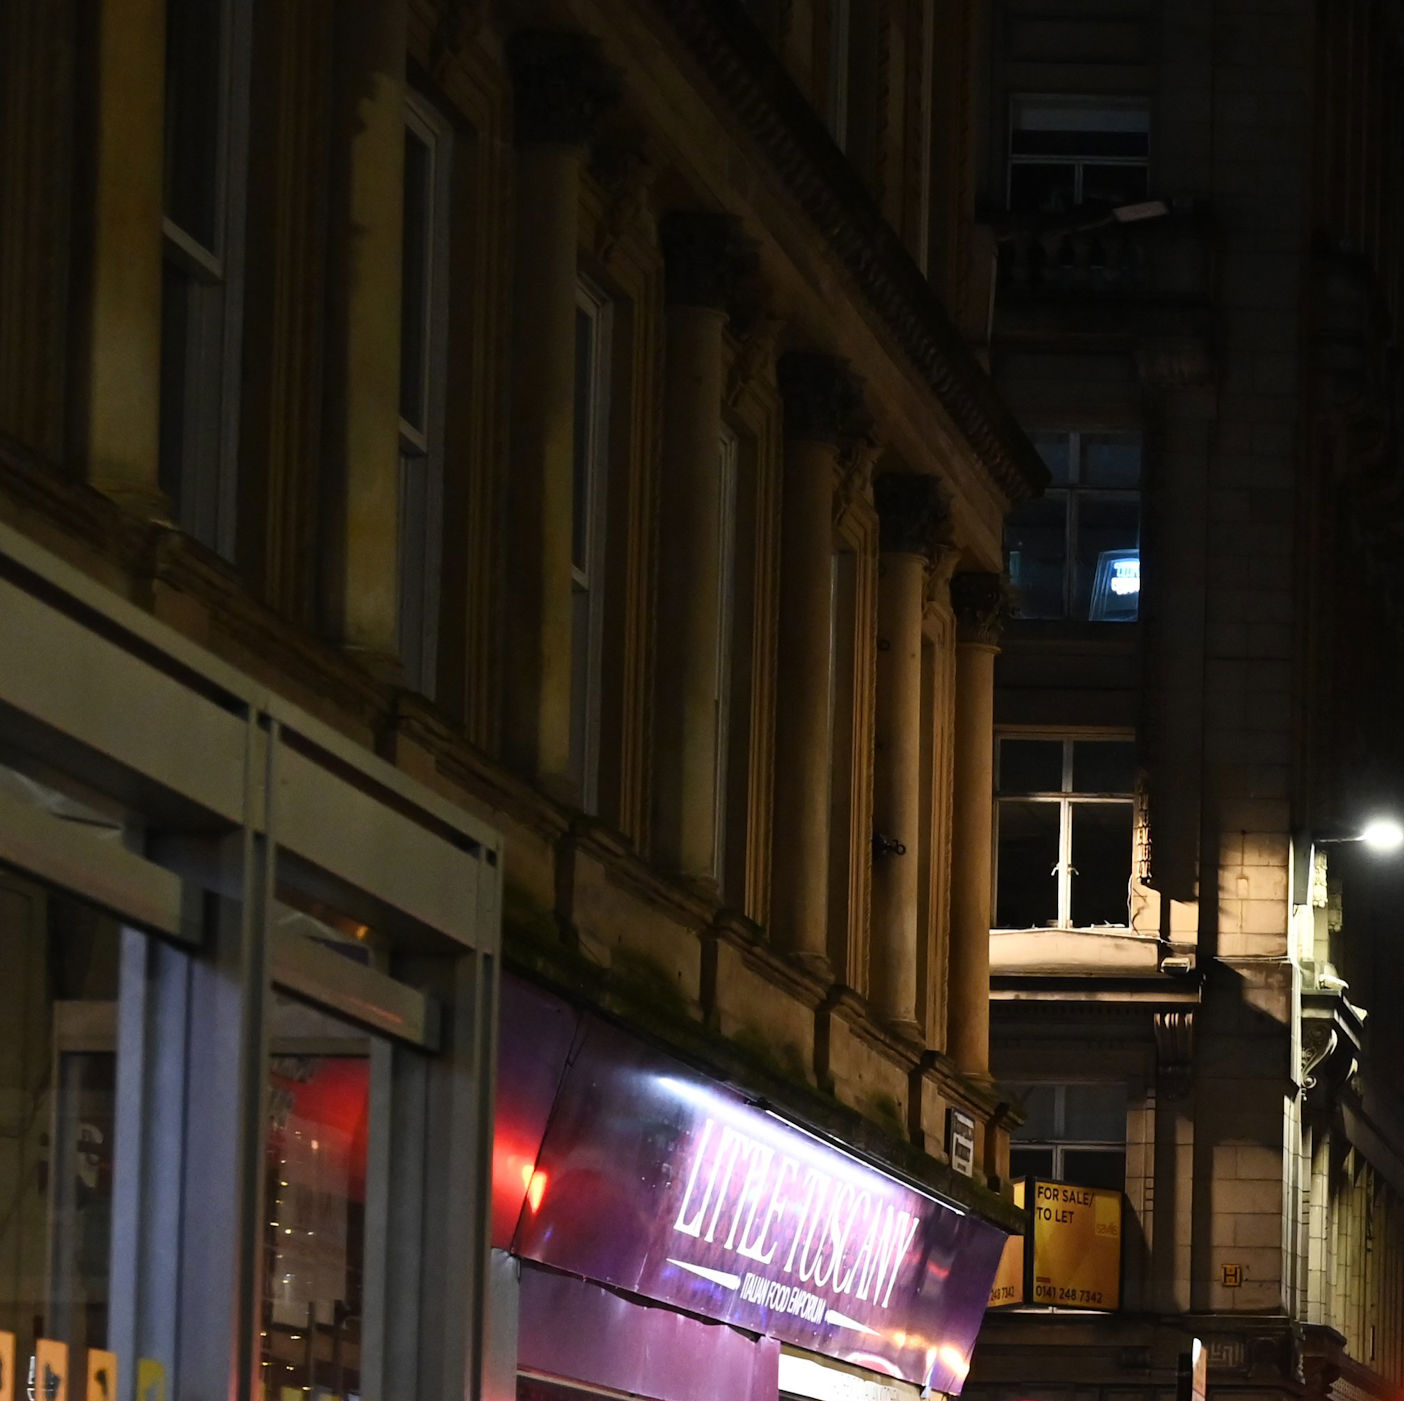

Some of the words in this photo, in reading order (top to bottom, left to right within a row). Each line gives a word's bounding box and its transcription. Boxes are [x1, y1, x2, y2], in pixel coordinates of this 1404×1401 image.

[1037, 1186, 1060, 1200] FOR
[1062, 1190, 1095, 1208] SALE/
[673, 1119, 800, 1265] LITTLE
[783, 1165, 920, 1308] TUSCANY
[1037, 1207, 1052, 1221] TO
[1055, 1210, 1075, 1224] LET
[1036, 1285, 1057, 1298] 0141
[1059, 1287, 1077, 1301] 248
[1079, 1290, 1103, 1304] 7342
